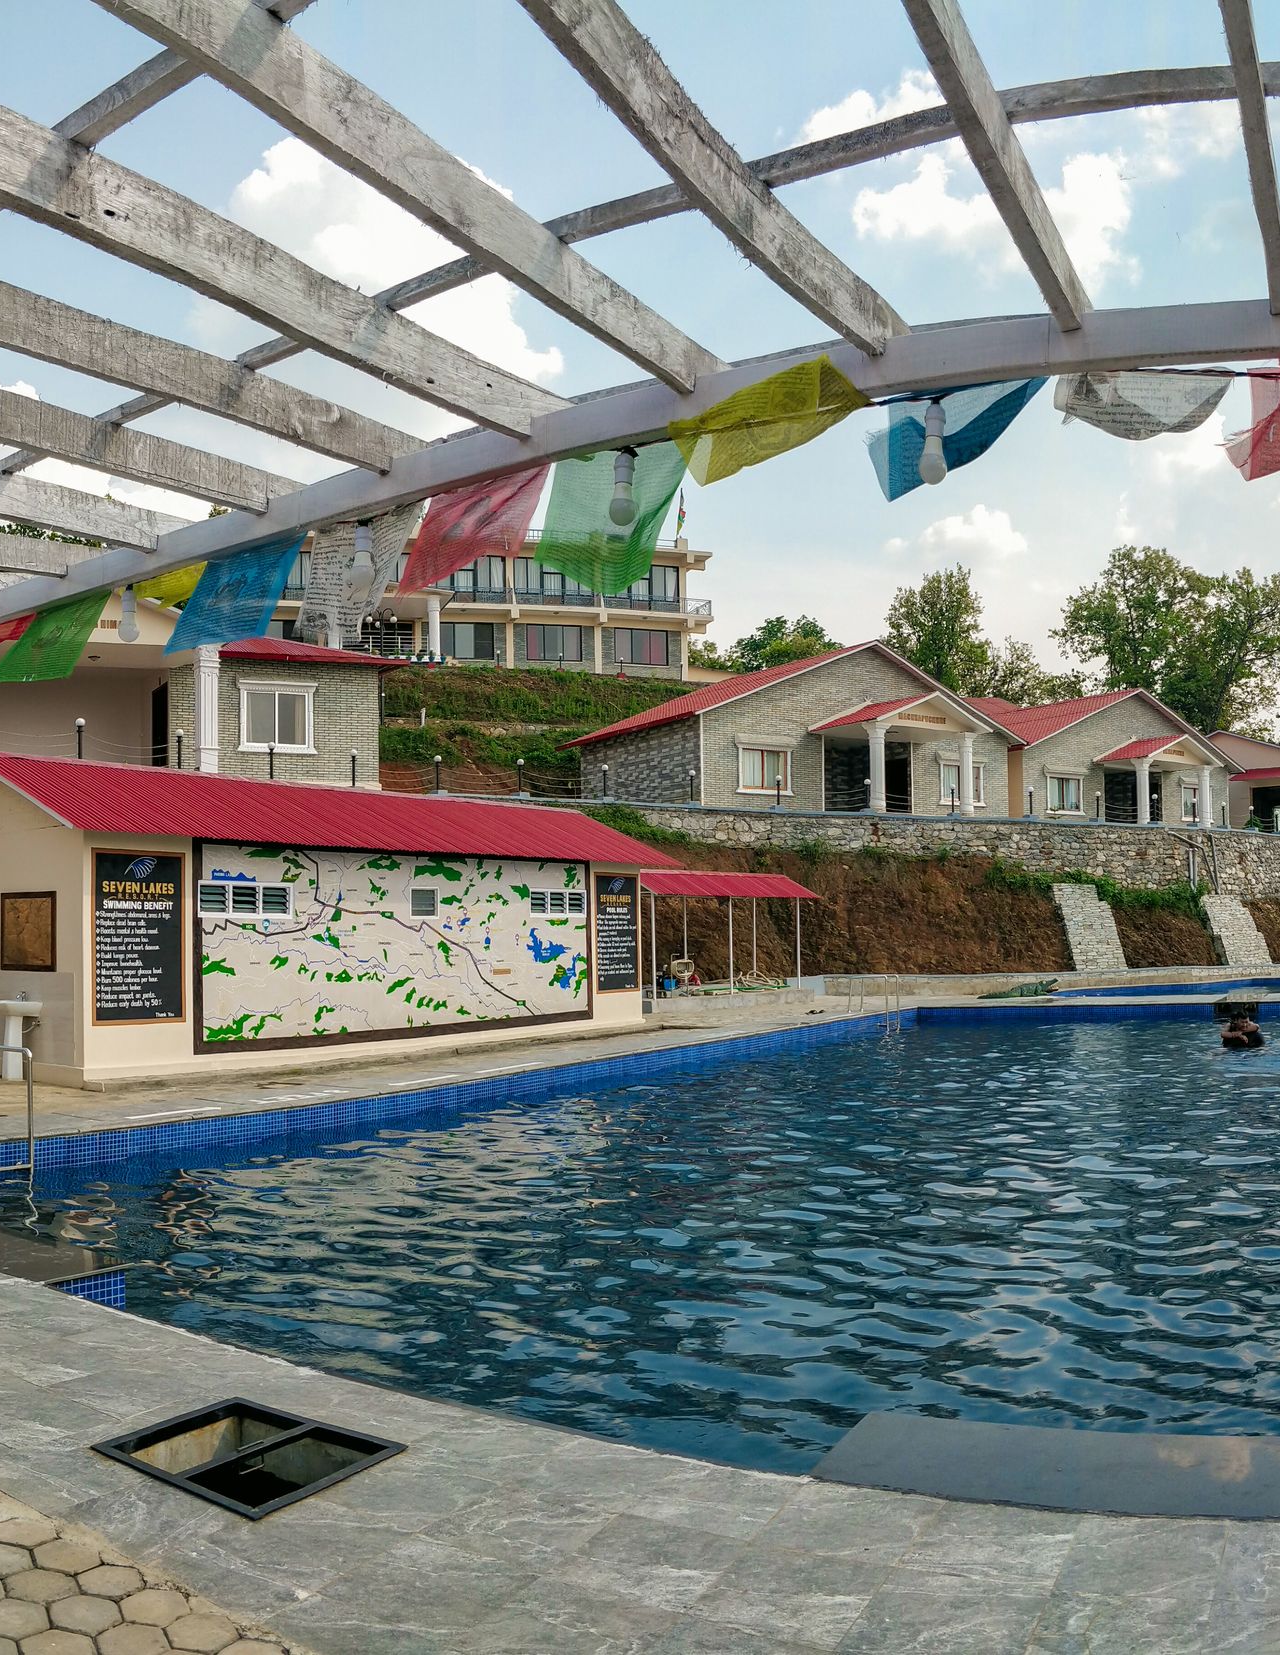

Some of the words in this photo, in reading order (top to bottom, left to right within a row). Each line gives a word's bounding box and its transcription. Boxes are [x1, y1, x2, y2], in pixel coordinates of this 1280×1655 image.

[102, 880, 140, 894] SEVEN
[142, 882, 175, 895] LAKES
[600, 894, 616, 903] SEVEN
[616, 894, 632, 903] LAKES
[103, 899, 142, 910] SWIMMING
[143, 901, 174, 910] BENEFIT
[100, 936, 111, 944] Keep
[144, 1000, 150, 1008] by
